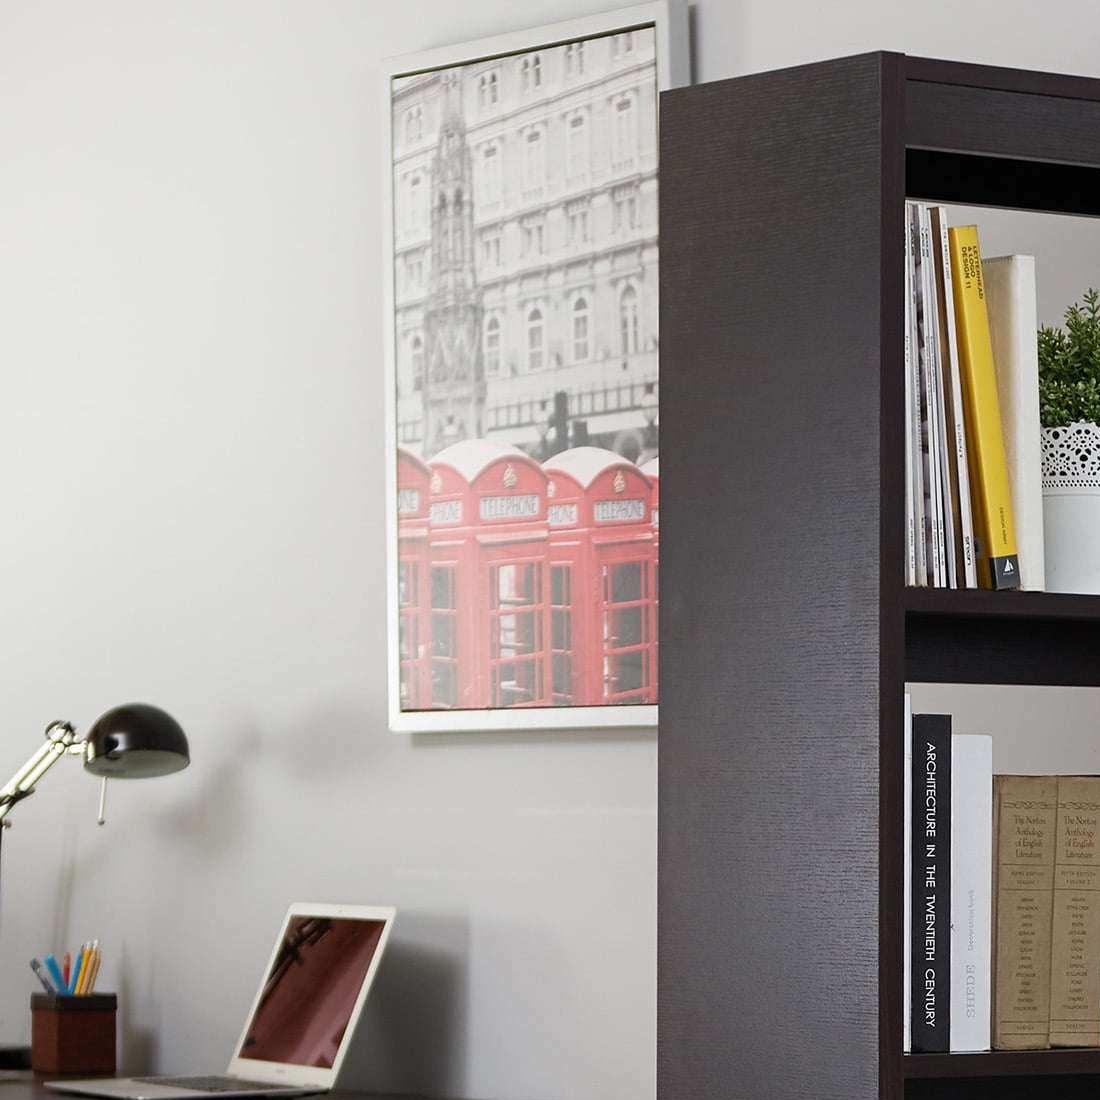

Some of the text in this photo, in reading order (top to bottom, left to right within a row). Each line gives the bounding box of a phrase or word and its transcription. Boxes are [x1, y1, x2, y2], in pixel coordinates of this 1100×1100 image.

[961, 246, 970, 279] DESIGN
[968, 254, 976, 278] LOGO
[972, 245, 984, 300] LETTERHEAD
[482, 495, 538, 519] TELEPHONE
[596, 500, 646, 520] TELEPHONE
[1015, 815, 1046, 825] The Norton
[1064, 815, 1097, 825] The Norton
[1016, 826, 1043, 838] Anthology
[1065, 826, 1094, 838] Anthology
[1022, 838, 1043, 848] English
[1073, 838, 1095, 849] English
[1015, 849, 1042, 858] Literature
[1066, 849, 1093, 858] Literature
[925, 741, 937, 1027] ARCHITECTURE IN THE TWENTIETH CENTURY
[966, 964, 976, 1019] SHEDE
